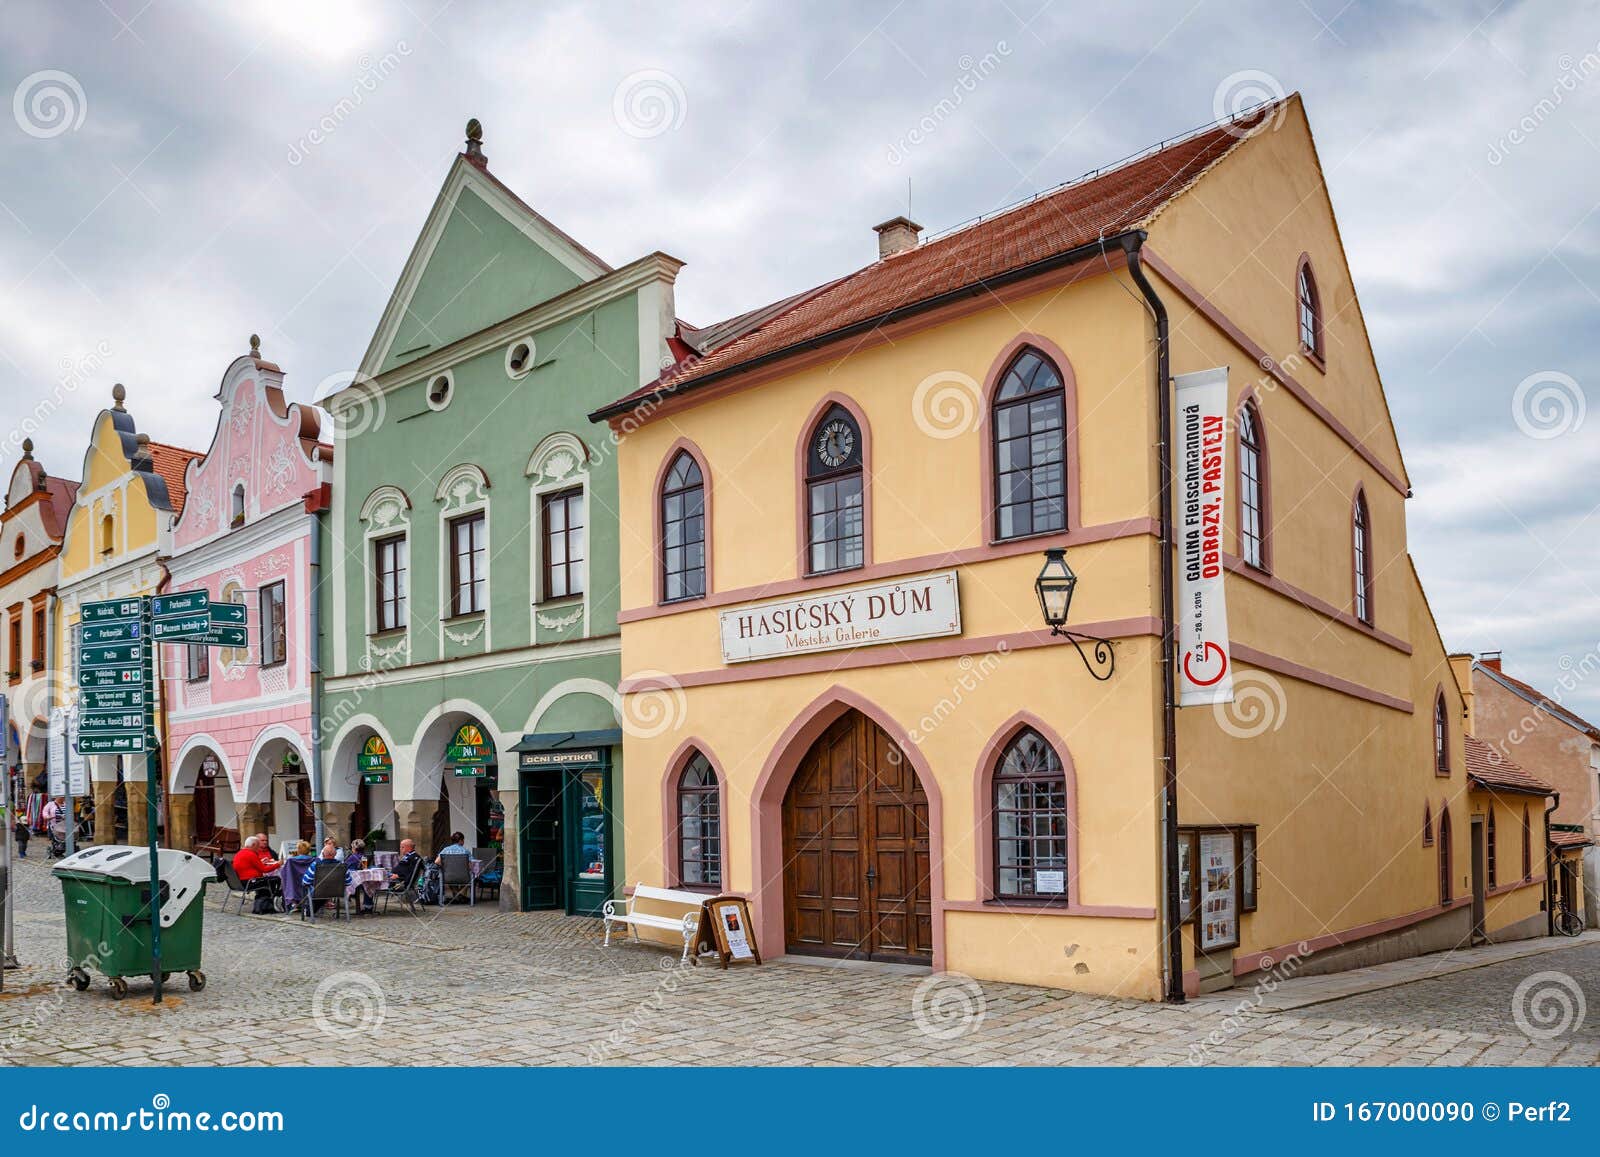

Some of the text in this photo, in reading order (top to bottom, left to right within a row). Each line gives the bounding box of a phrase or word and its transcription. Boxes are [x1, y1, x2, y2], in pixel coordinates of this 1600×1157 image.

[1183, 404, 1200, 581] GALINA Fleischmannová
[1202, 415, 1223, 579] OBRAZY, PASTELY
[738, 586, 933, 639] HASIČSKÝ DŮM
[1194, 591, 1202, 609] 2015
[835, 625, 880, 643] Galerie
[553, 752, 592, 763] OPTIKA
